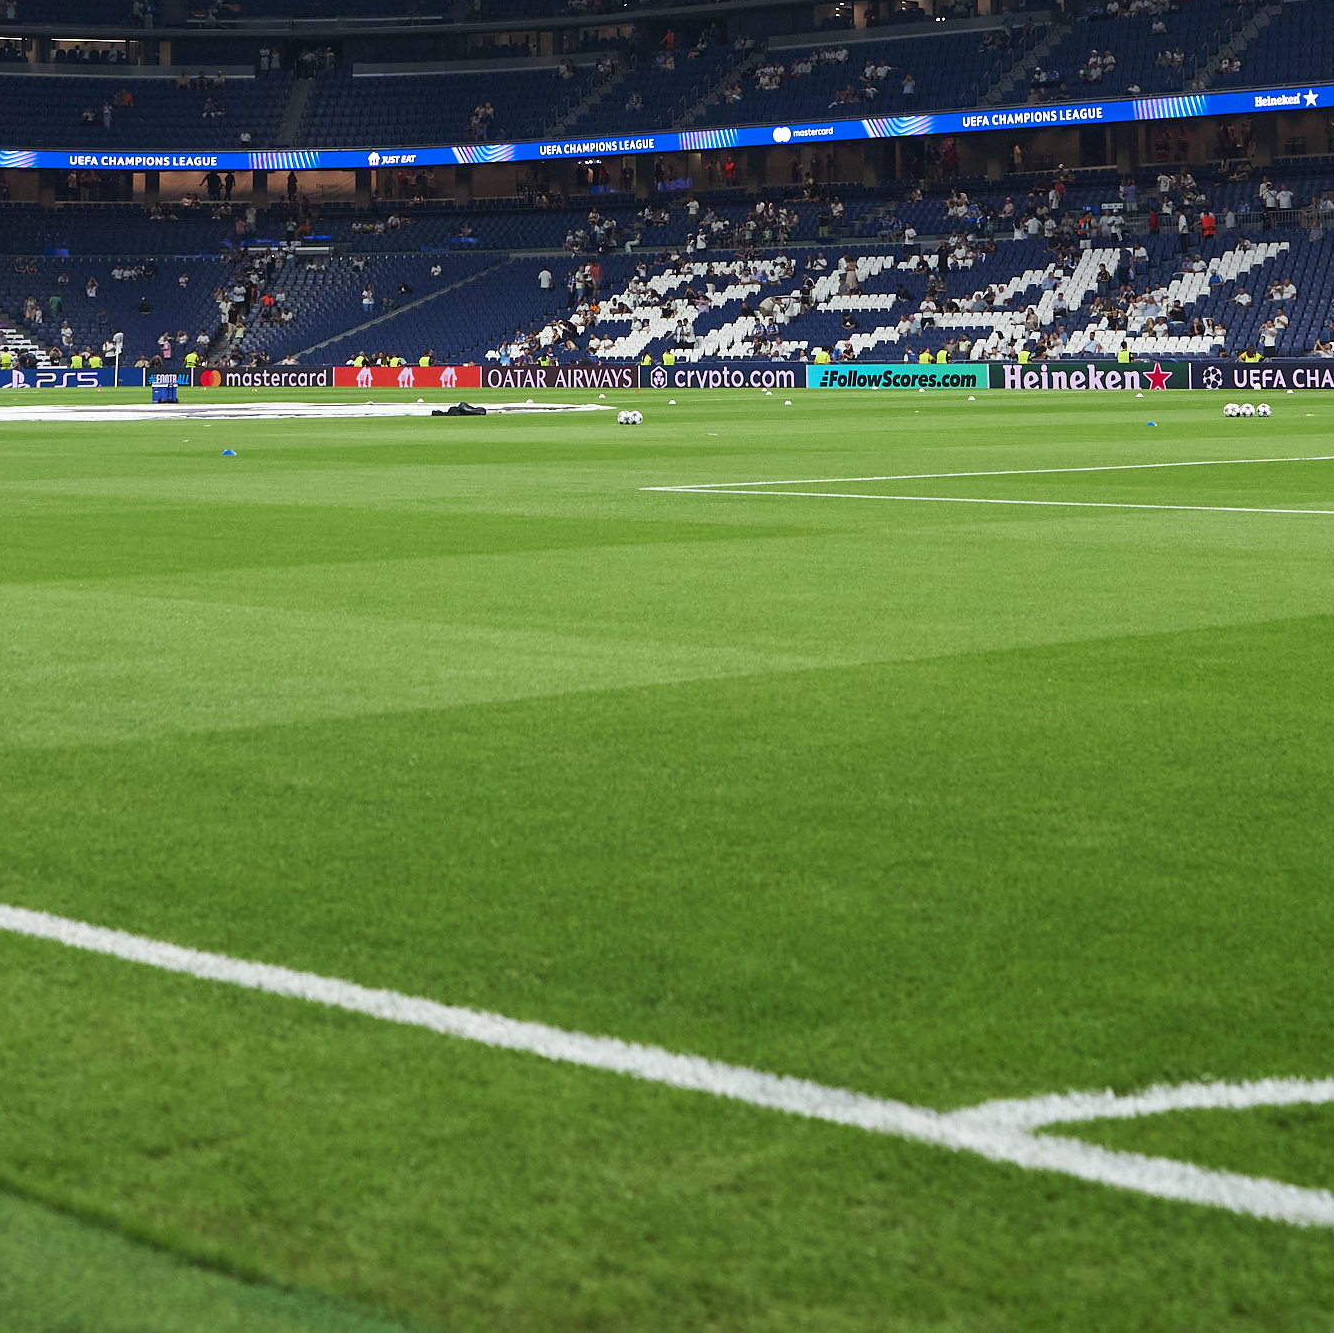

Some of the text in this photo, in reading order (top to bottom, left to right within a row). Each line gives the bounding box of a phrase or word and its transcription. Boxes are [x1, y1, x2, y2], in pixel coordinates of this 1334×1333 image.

[1254, 93, 1301, 108] Heineken
[963, 108, 1103, 128] UEFA CHAMPIONS LEAGUE
[793, 127, 833, 137] mastercard
[539, 139, 654, 156] UEFA CHAMPIONS LEAGUE
[70, 156, 217, 166] UEFA CHAMPIONS LEAGUE
[381, 155, 416, 165] JUST EAT
[39, 372, 99, 388] PS5
[226, 370, 328, 387] mastercard
[487, 367, 633, 387] QATAR AIRWAYS
[674, 369, 795, 388] crypto.com
[1004, 365, 1141, 390] Heineken
[1233, 368, 1285, 389] UEFA
